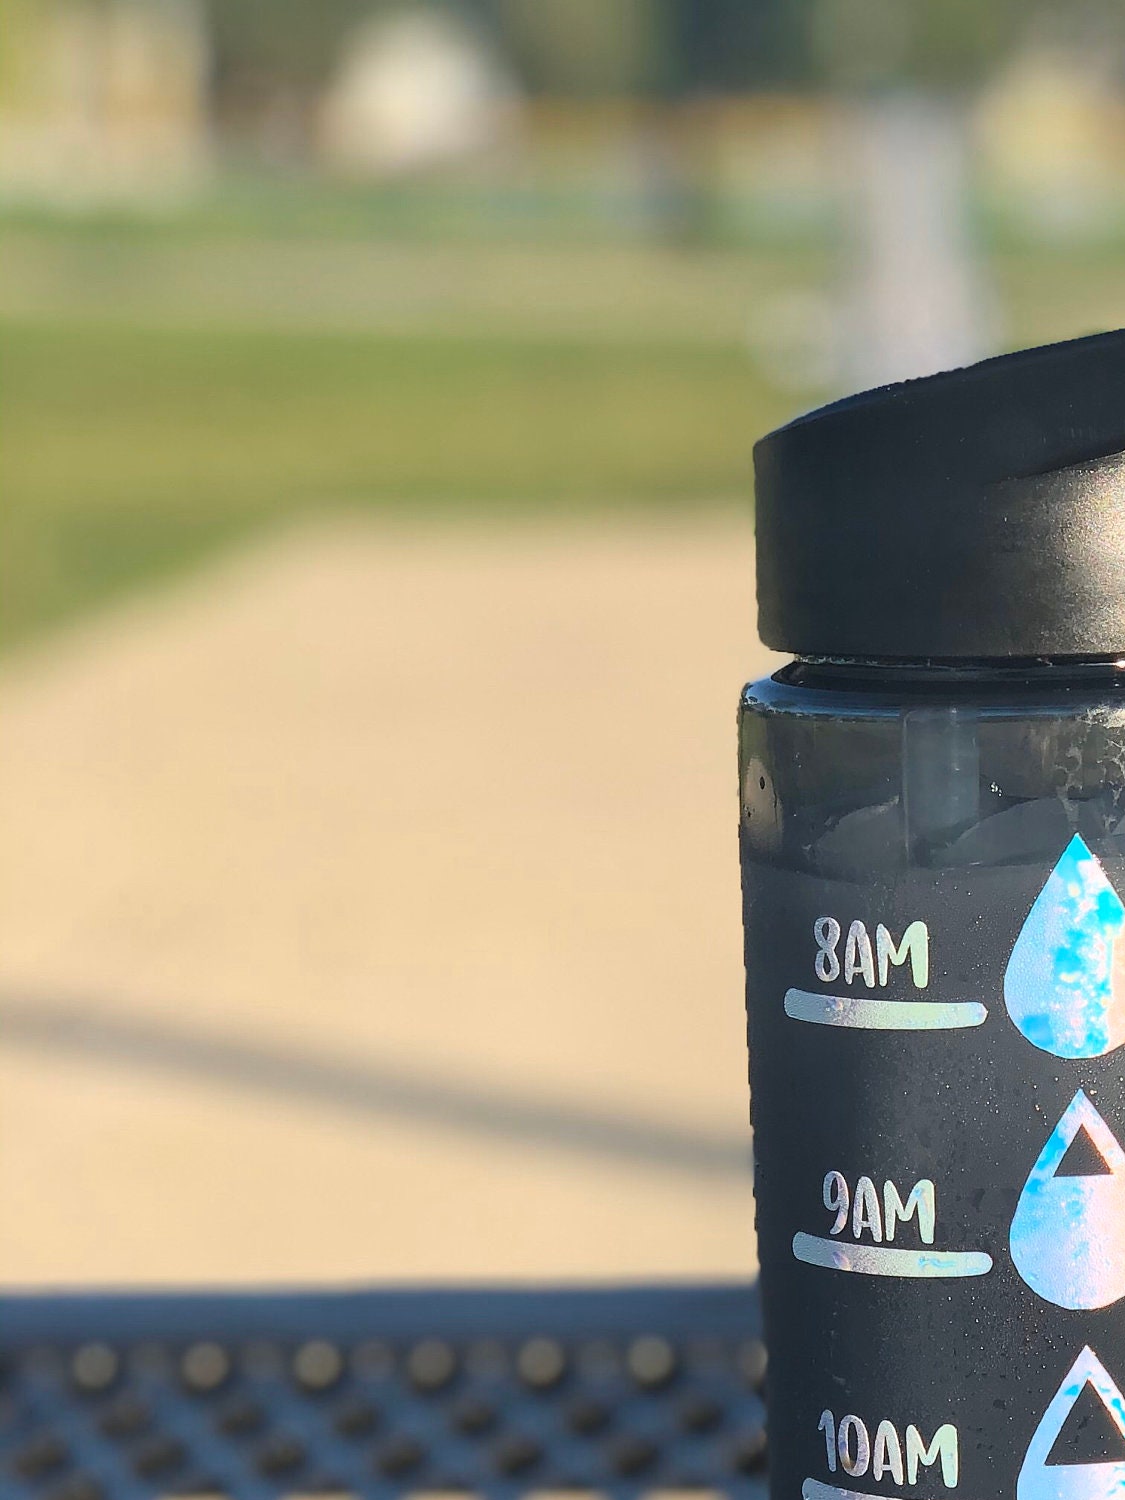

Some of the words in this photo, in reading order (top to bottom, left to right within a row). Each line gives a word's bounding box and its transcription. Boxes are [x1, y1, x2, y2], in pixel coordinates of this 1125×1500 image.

[813, 916, 929, 989] 8AM
[823, 1171, 935, 1244] 9AM
[817, 1409, 959, 1488] 10AM
